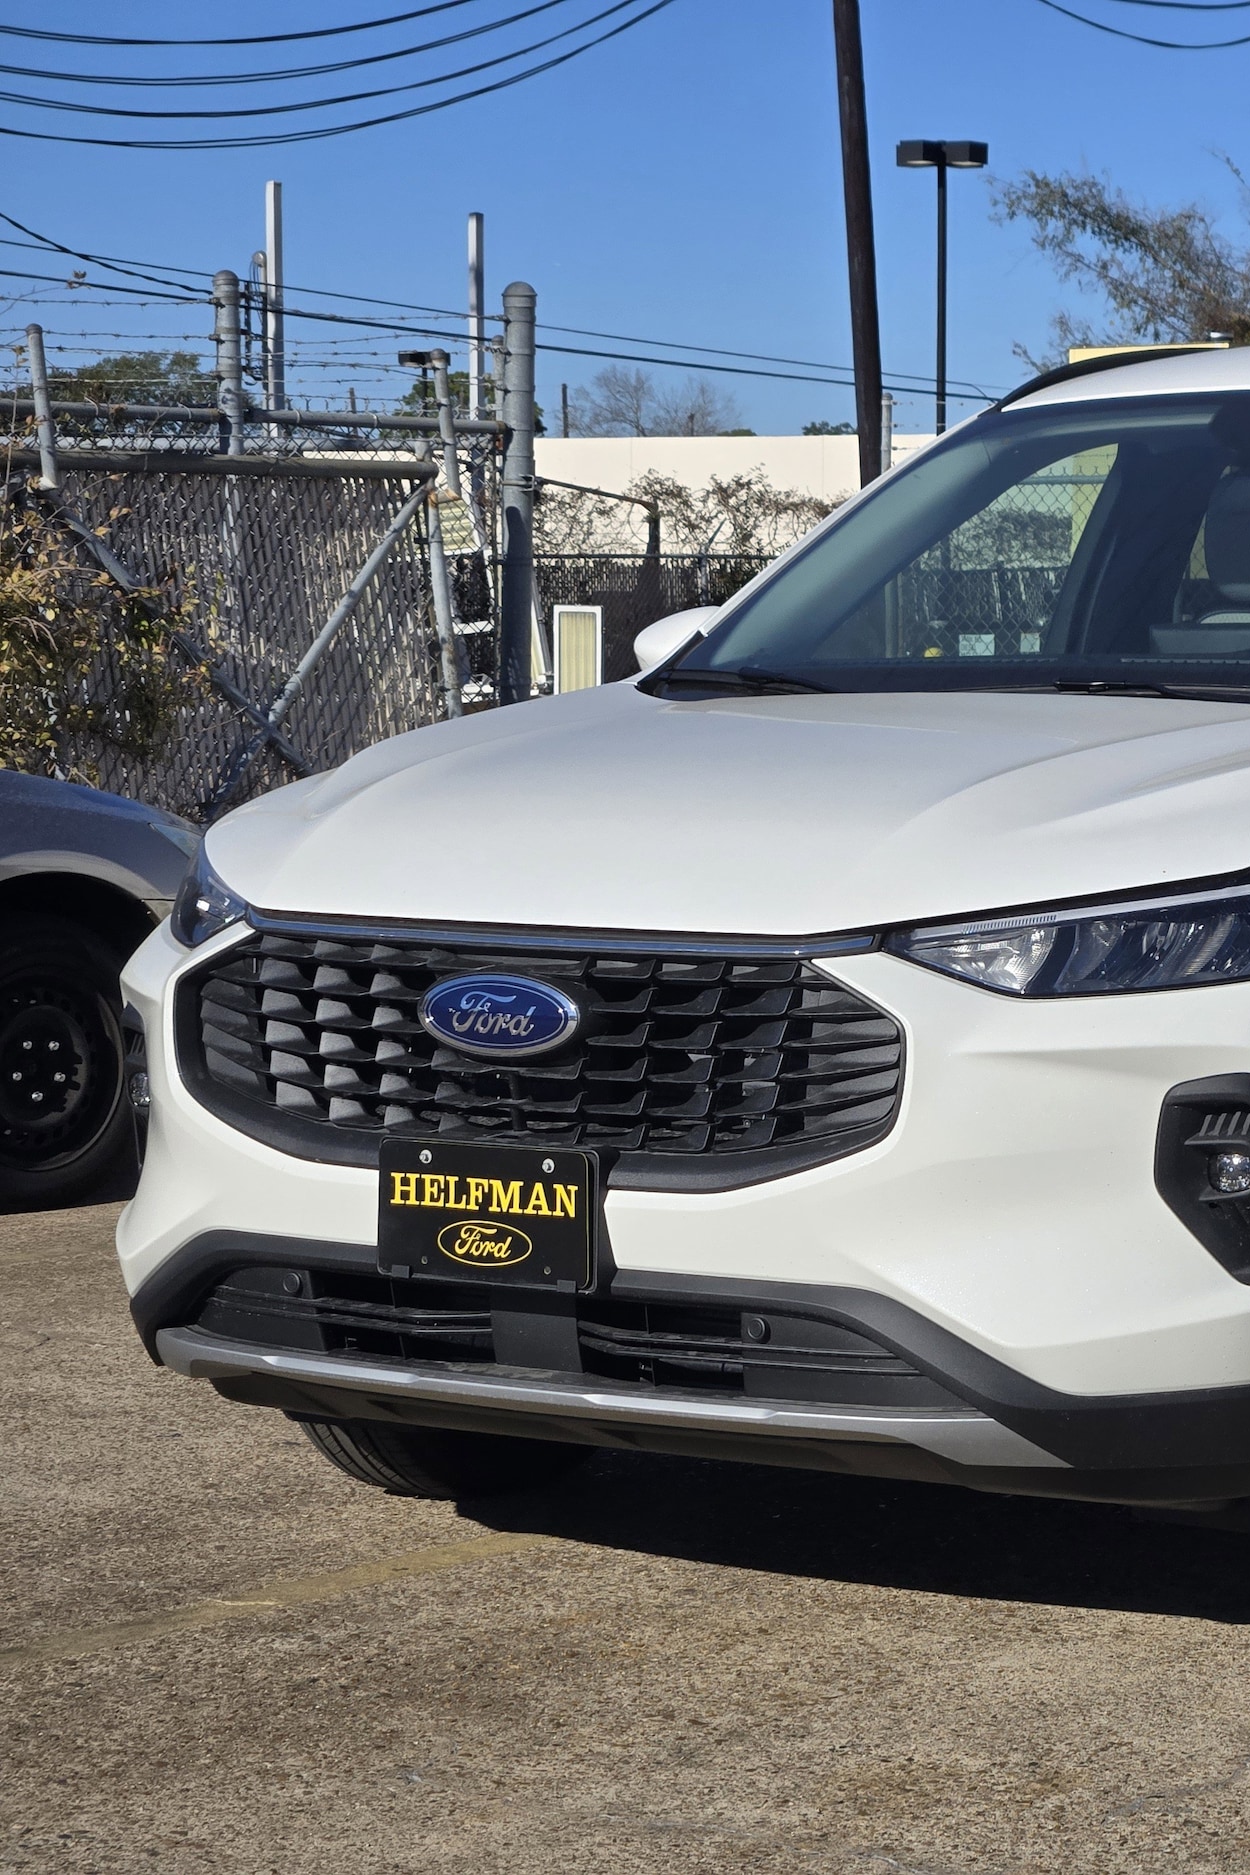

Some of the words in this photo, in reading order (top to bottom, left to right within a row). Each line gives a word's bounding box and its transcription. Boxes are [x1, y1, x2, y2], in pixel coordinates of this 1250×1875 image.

[451, 990, 537, 1037] Ford
[389, 1171, 579, 1218] HELFMAN
[454, 1224, 513, 1259] Ford
